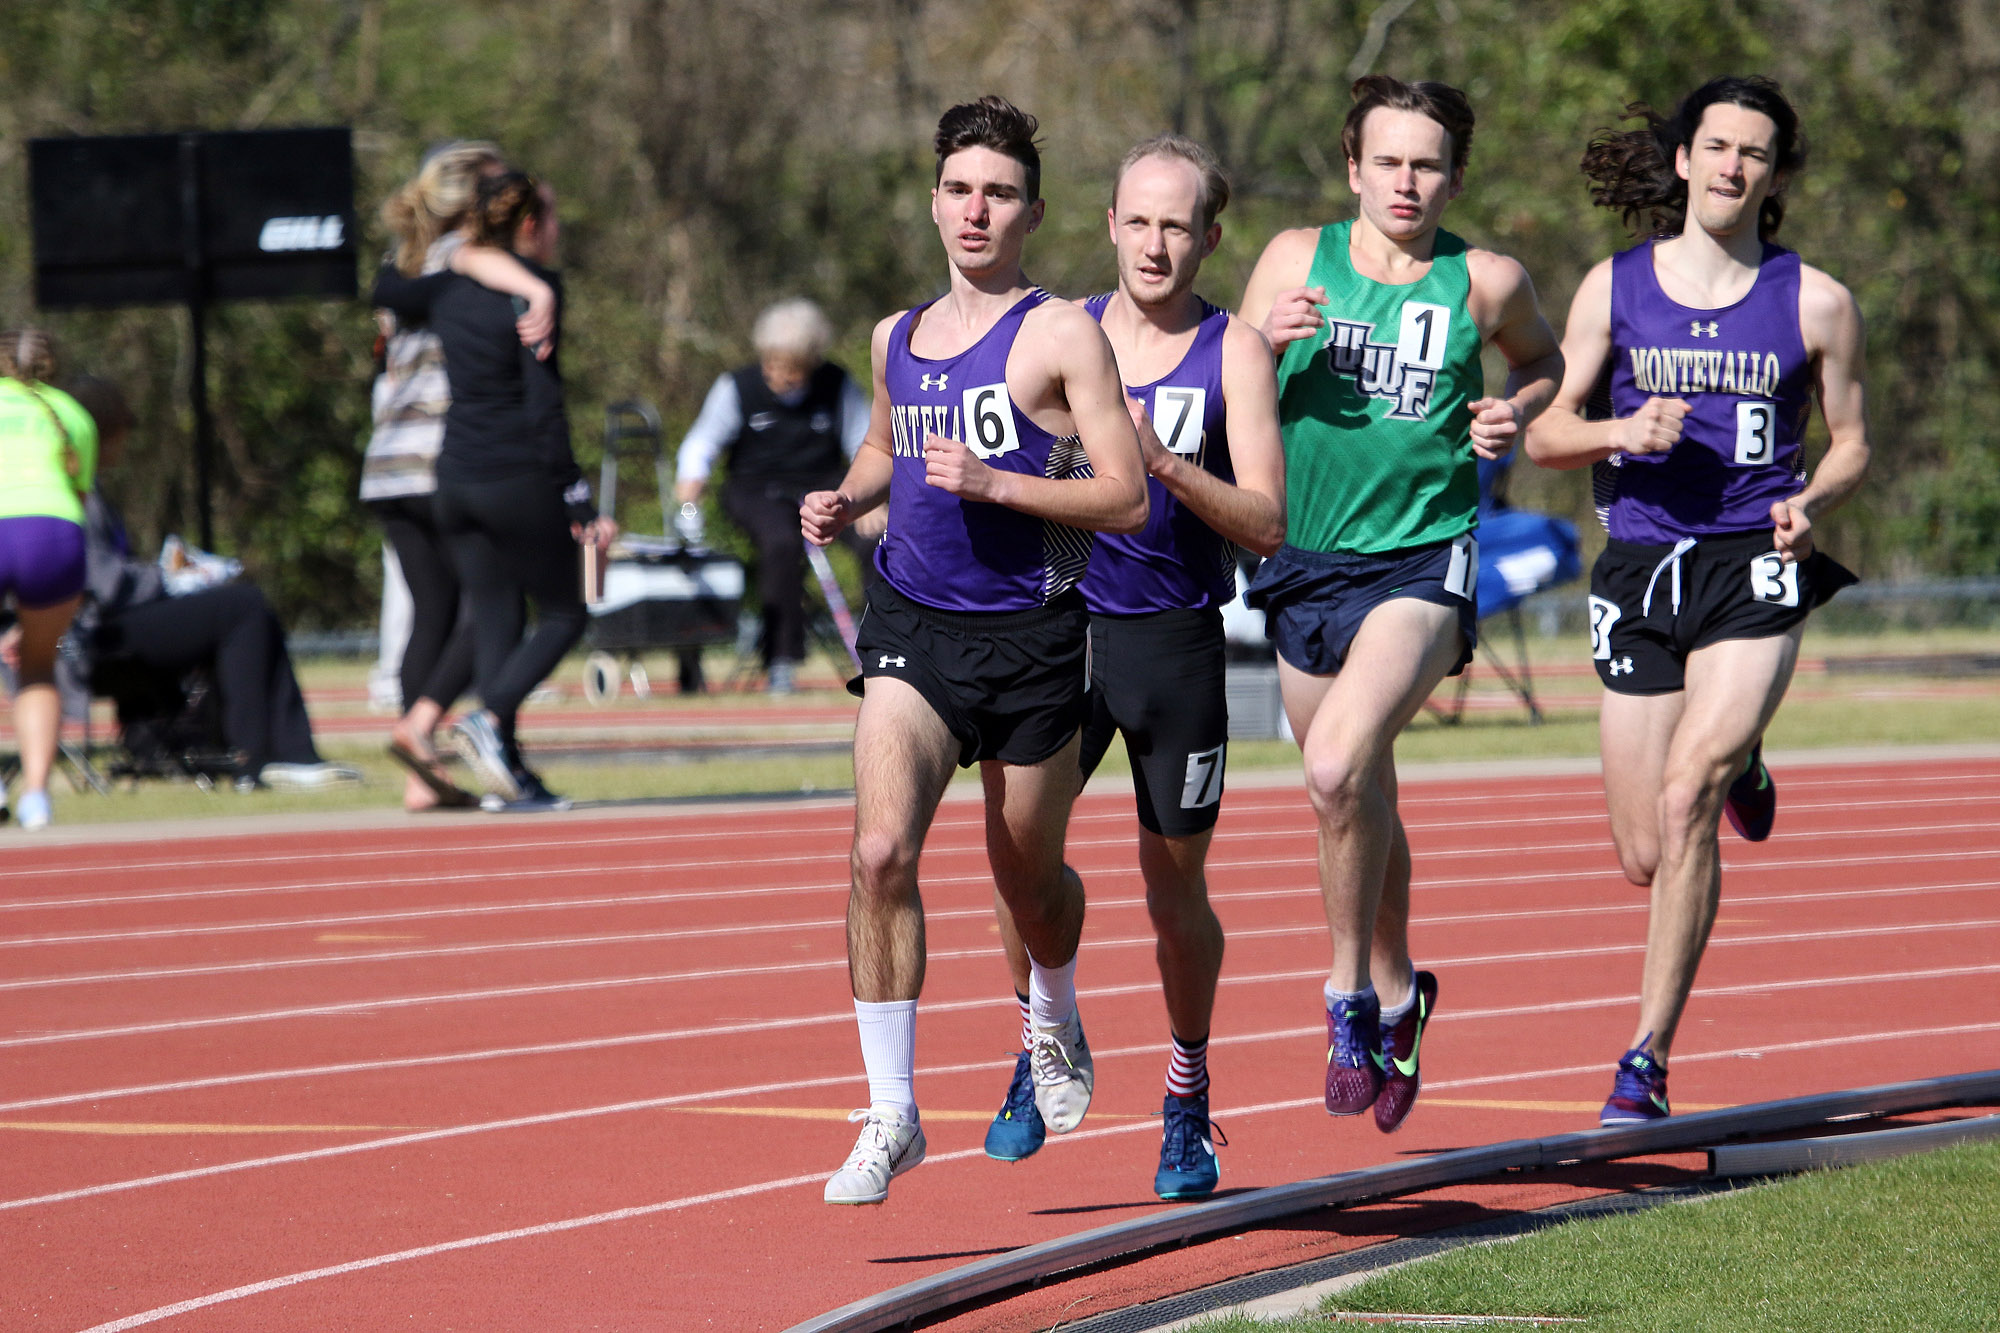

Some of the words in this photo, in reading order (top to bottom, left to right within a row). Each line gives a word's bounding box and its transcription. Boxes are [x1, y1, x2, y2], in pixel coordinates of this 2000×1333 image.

[1415, 309, 1434, 362] 1
[1323, 318, 1440, 422] UWF
[1629, 347, 1780, 397] MONTEVALLO
[974, 389, 1005, 450] 6
[1166, 391, 1194, 449] 7
[1746, 407, 1769, 461] 3
[1462, 541, 1472, 594] 1
[1763, 556, 1787, 602] 3
[1194, 751, 1219, 805] 7
